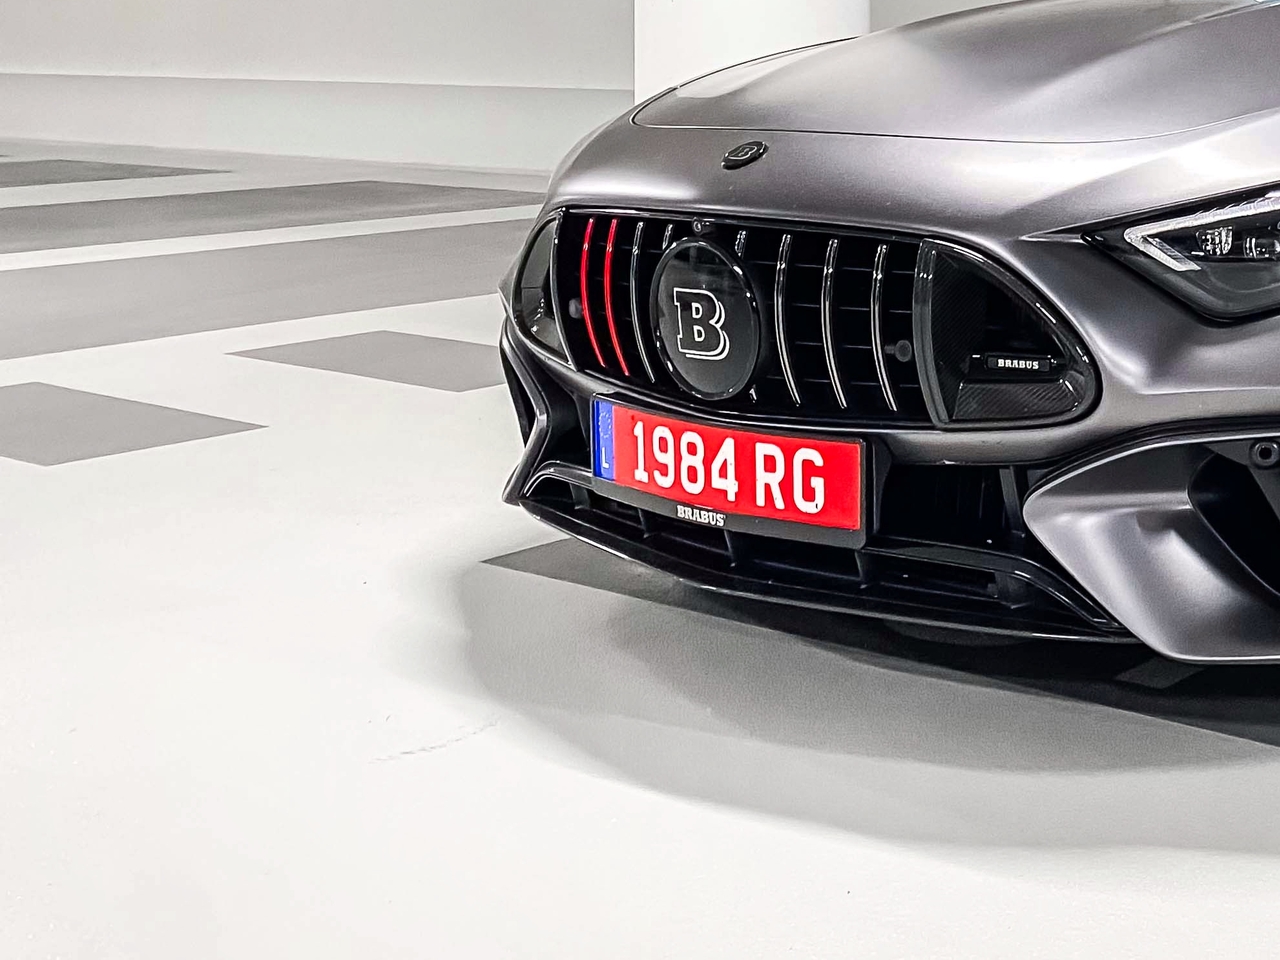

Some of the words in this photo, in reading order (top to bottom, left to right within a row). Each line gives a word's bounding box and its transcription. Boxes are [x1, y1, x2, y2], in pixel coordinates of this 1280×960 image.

[673, 287, 730, 360] B
[997, 358, 1039, 370] BRABUS
[600, 447, 610, 469] L
[632, 420, 739, 502] 1984
[754, 441, 826, 514] RG
[676, 504, 726, 527] BRABUS
